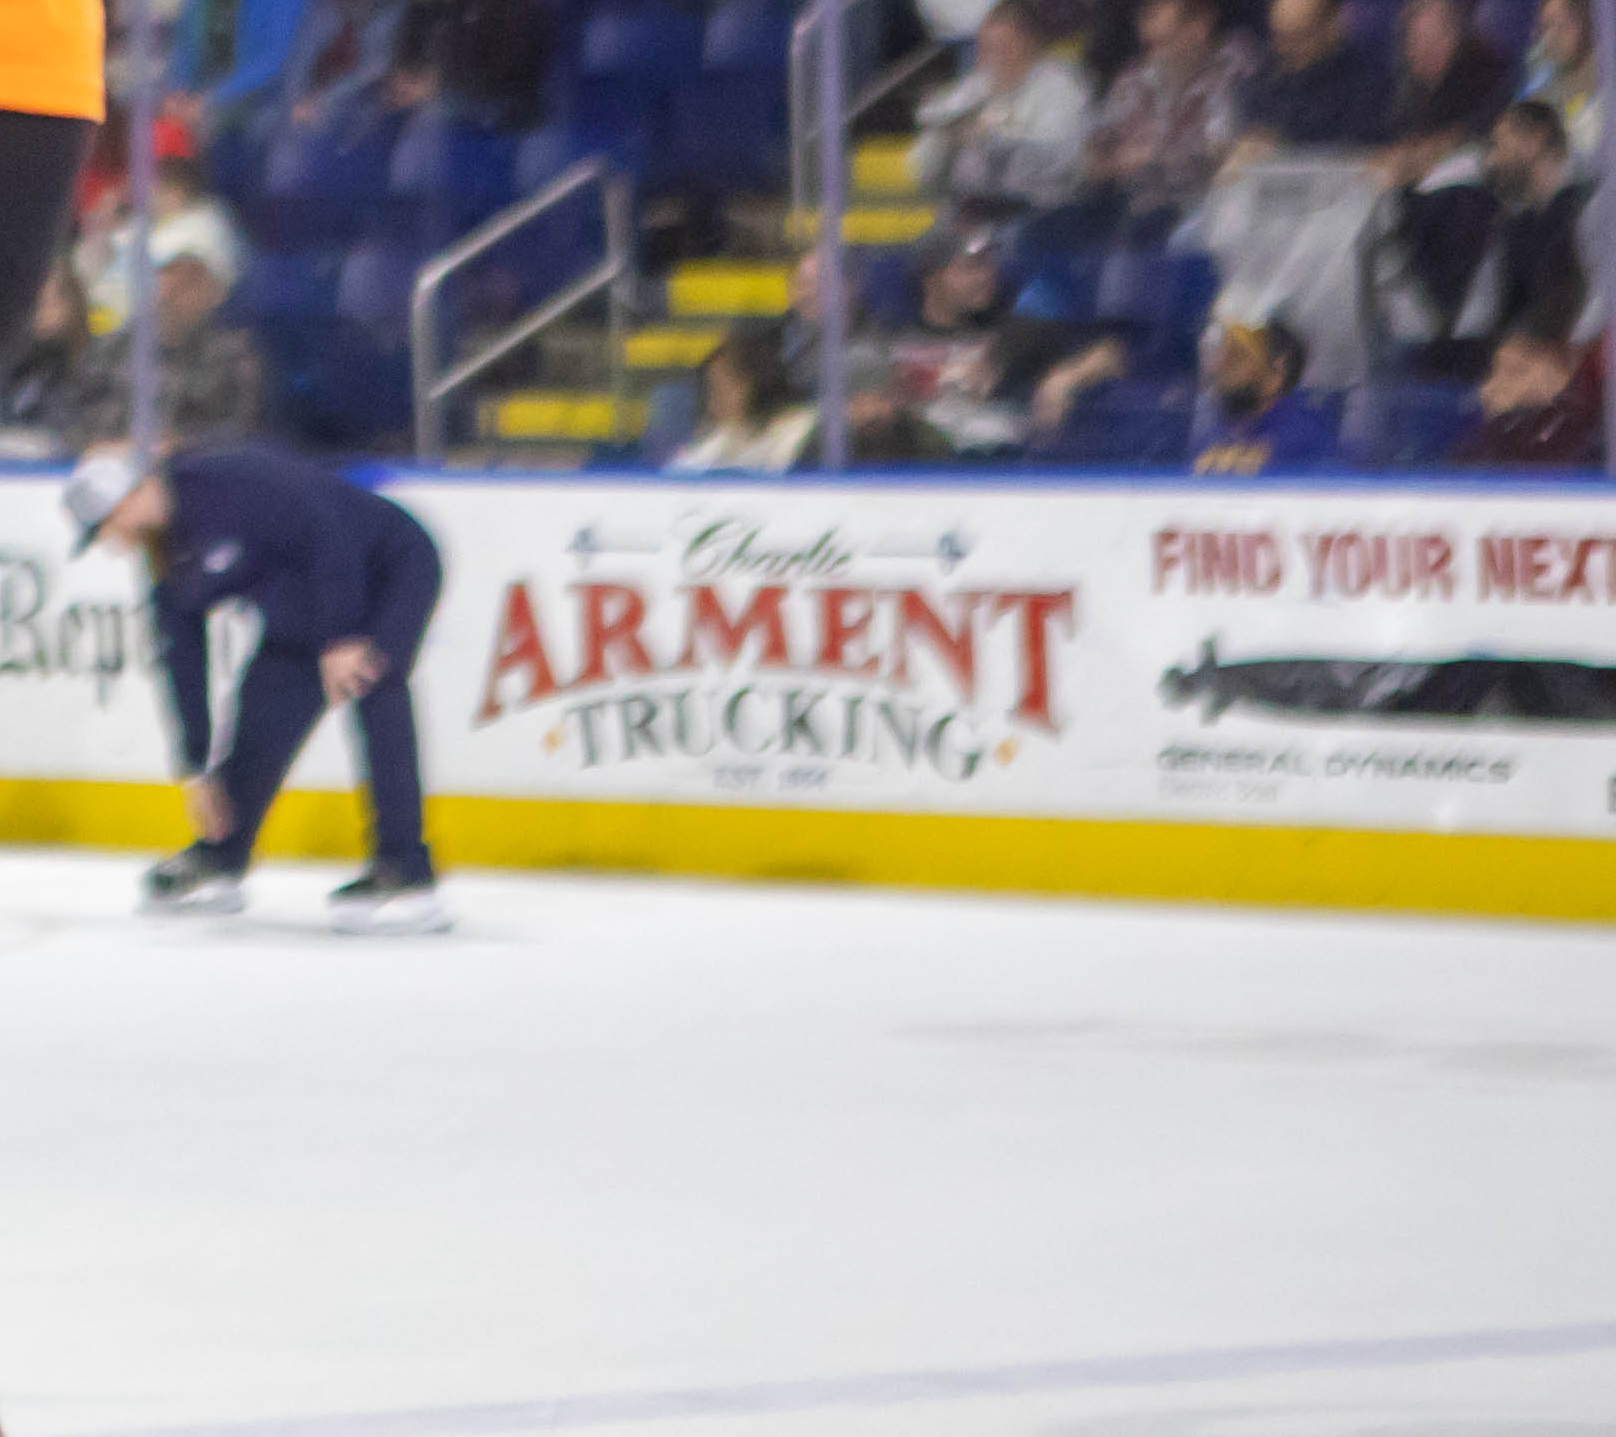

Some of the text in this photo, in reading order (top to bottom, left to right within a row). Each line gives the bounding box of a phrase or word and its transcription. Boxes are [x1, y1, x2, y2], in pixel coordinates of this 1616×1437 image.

[1152, 529, 1285, 599] FIND
[1301, 531, 1457, 603] YOUR
[474, 577, 1079, 739] ARMENT
[565, 684, 984, 784] TRUCKING
